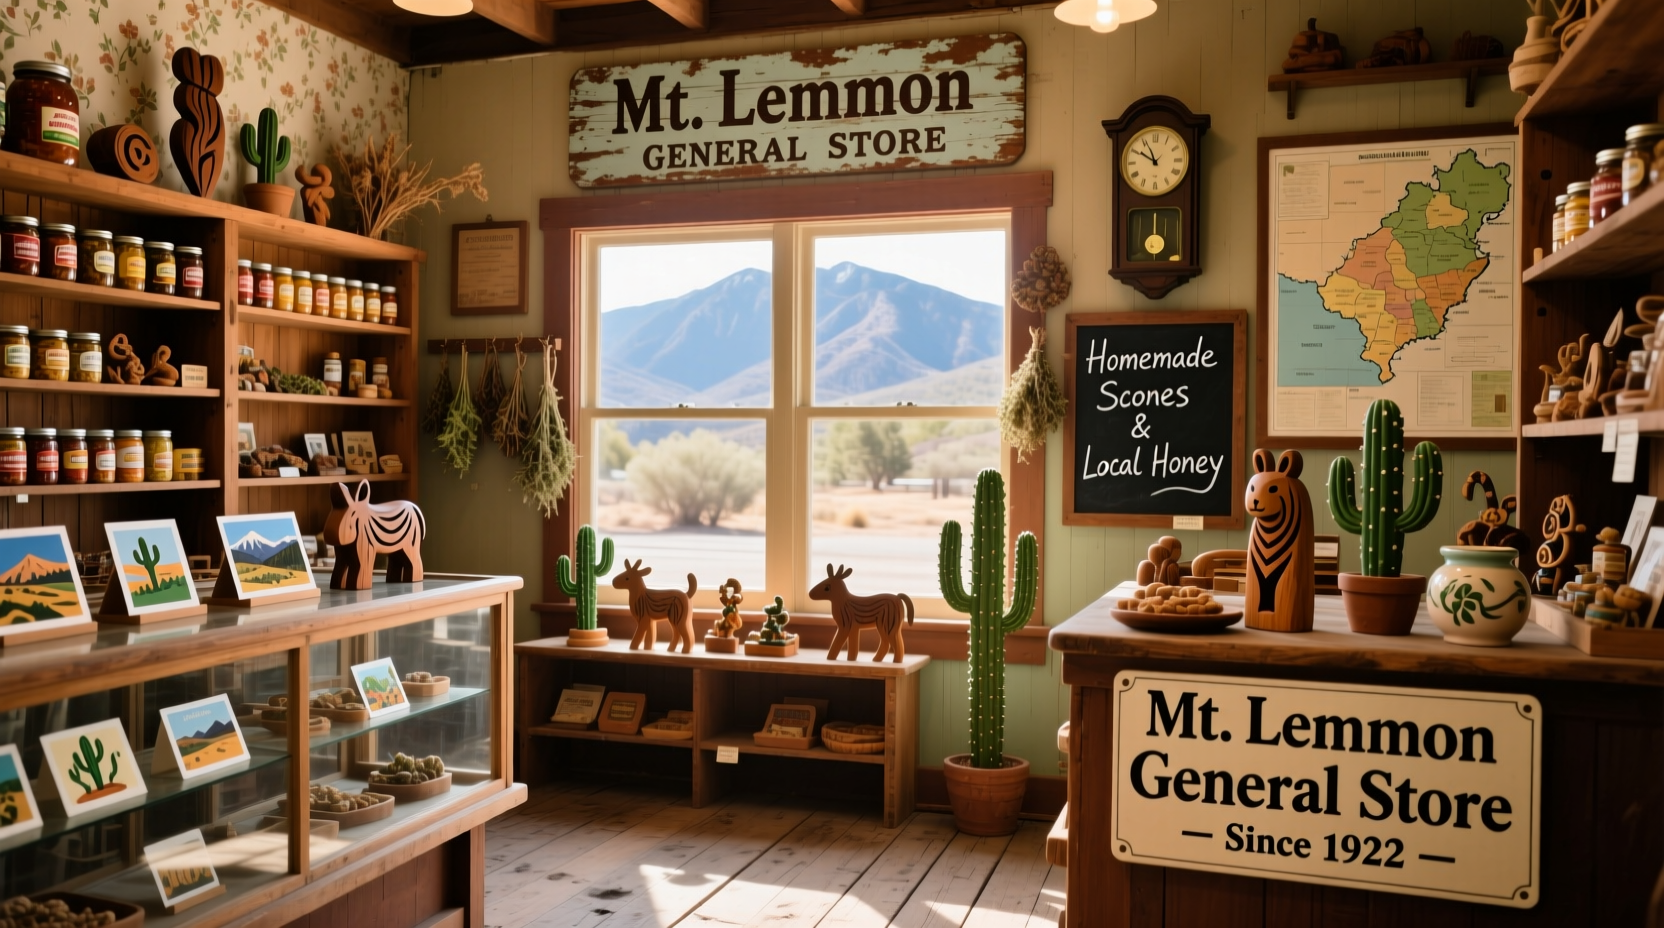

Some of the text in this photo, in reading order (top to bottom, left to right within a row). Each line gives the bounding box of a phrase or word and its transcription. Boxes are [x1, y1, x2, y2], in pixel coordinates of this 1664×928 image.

[611, 68, 974, 135] Mt. Lemmon
[642, 126, 946, 171] GENERAL STORE
[1085, 335, 1218, 374] Homemade
[1096, 380, 1190, 411] Scones
[1130, 412, 1151, 439] &
[1082, 441, 1224, 497] Local Honey
[1145, 689, 1498, 764] Mt. Lemmon
[1129, 749, 1513, 833] General Store
[1224, 822, 1406, 869] Since 1922
